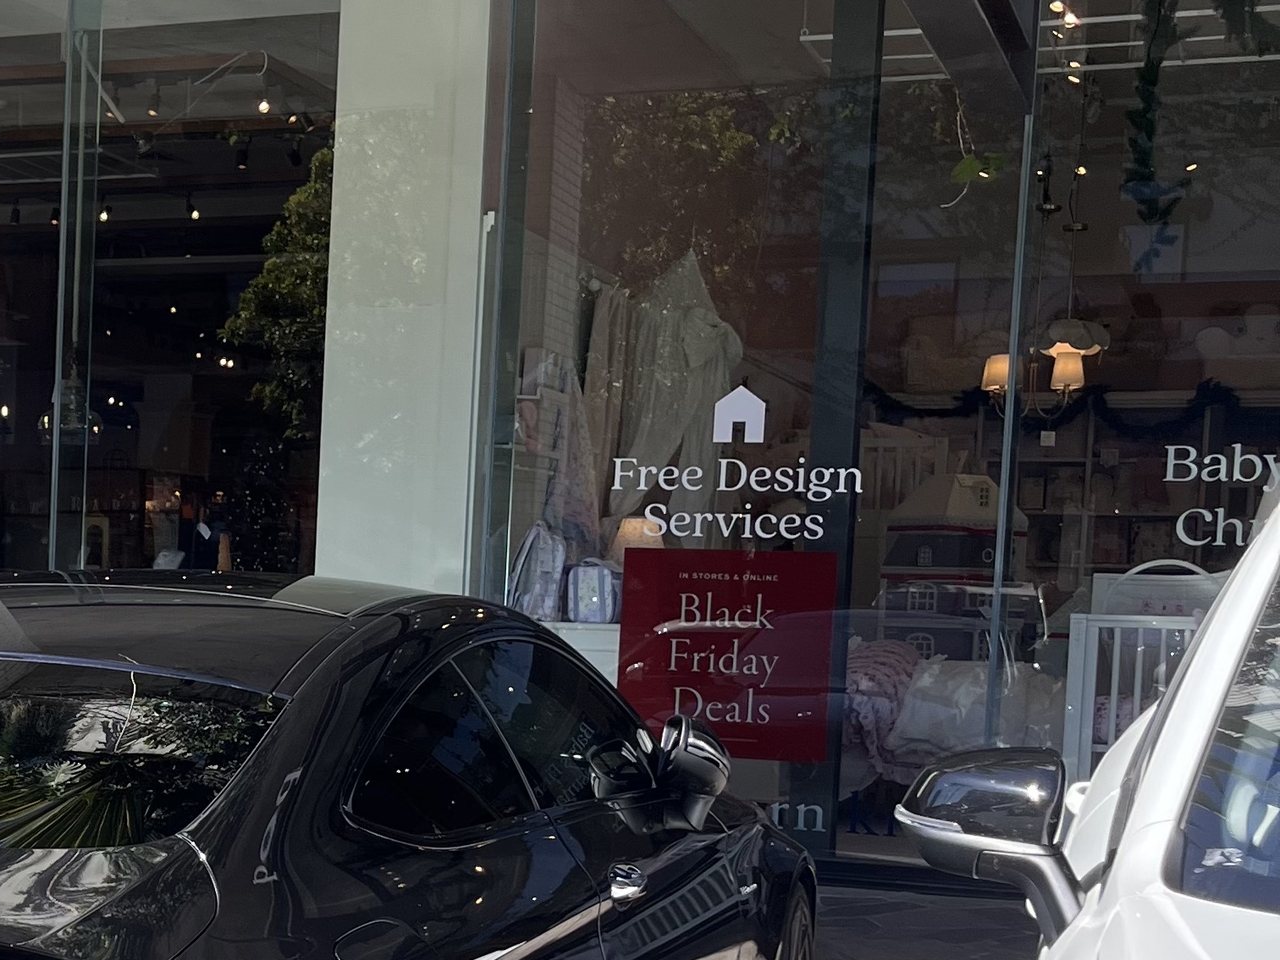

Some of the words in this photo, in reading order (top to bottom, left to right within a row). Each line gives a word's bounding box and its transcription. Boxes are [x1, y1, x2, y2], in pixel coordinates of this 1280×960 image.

[611, 457, 704, 491] Free
[716, 457, 864, 502] Design
[643, 502, 825, 540] Services
[692, 572, 730, 581] STORES
[742, 573, 779, 582] ONLINE
[679, 592, 775, 630] Black
[668, 638, 780, 689] Friday
[673, 686, 771, 724] Deals
